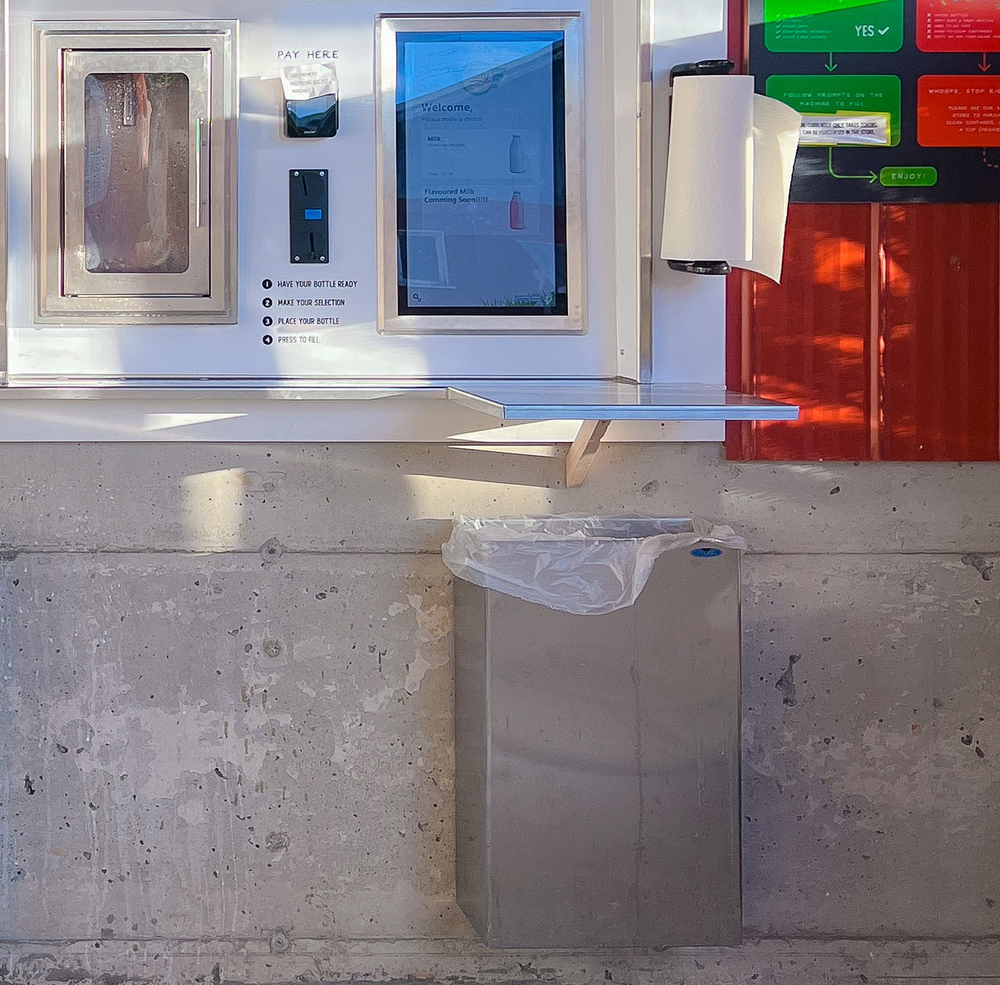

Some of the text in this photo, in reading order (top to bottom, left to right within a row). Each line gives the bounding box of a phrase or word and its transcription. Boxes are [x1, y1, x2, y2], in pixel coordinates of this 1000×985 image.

[854, 25, 875, 37] YES
[277, 50, 339, 59] PAY HERE
[421, 103, 473, 113] Welcome,
